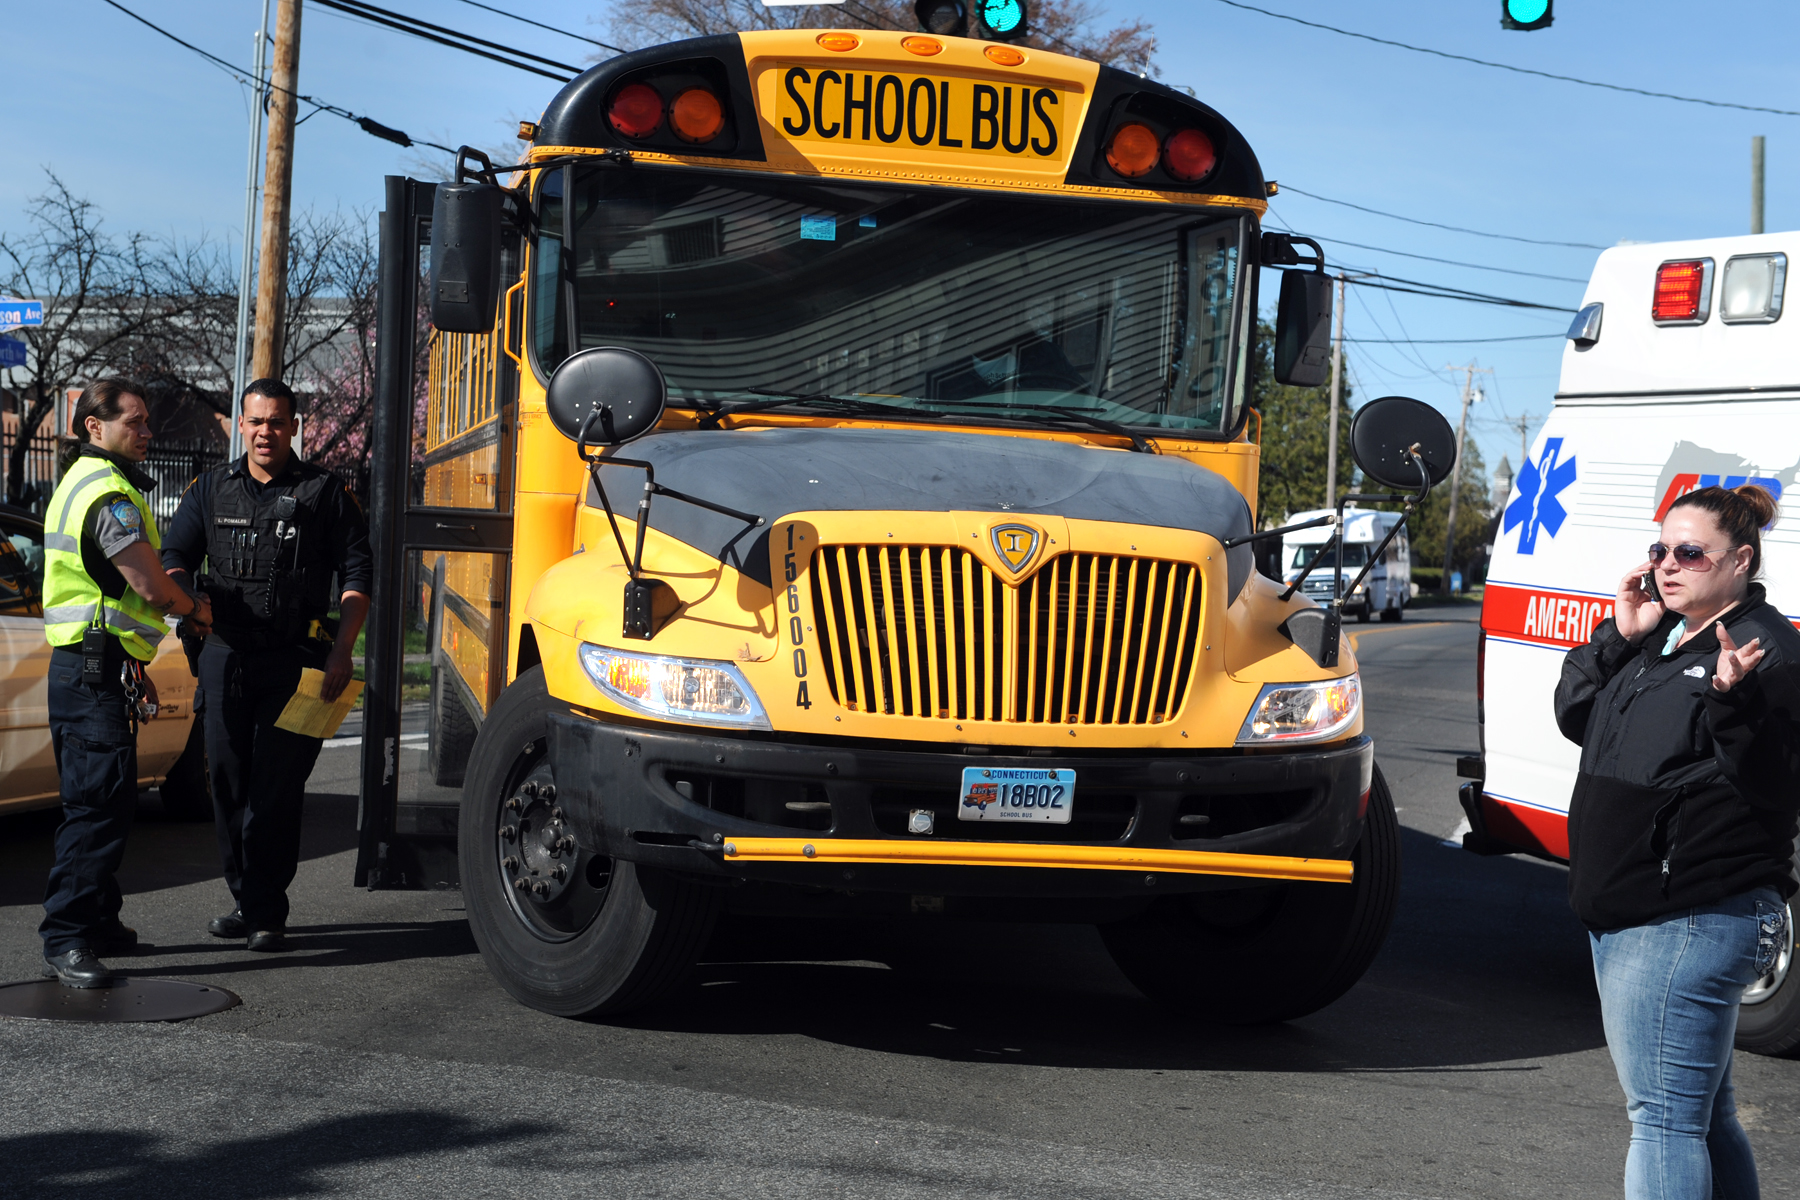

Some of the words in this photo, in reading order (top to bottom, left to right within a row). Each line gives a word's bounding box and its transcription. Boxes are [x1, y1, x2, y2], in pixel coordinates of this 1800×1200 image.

[783, 67, 963, 148] SCHOOL
[971, 84, 1059, 156] BUS
[25, 307, 41, 320] Ave
[784, 523, 813, 711] 156004
[992, 769, 1048, 780] CONNECTICUT
[1000, 783, 1065, 808] 18B02
